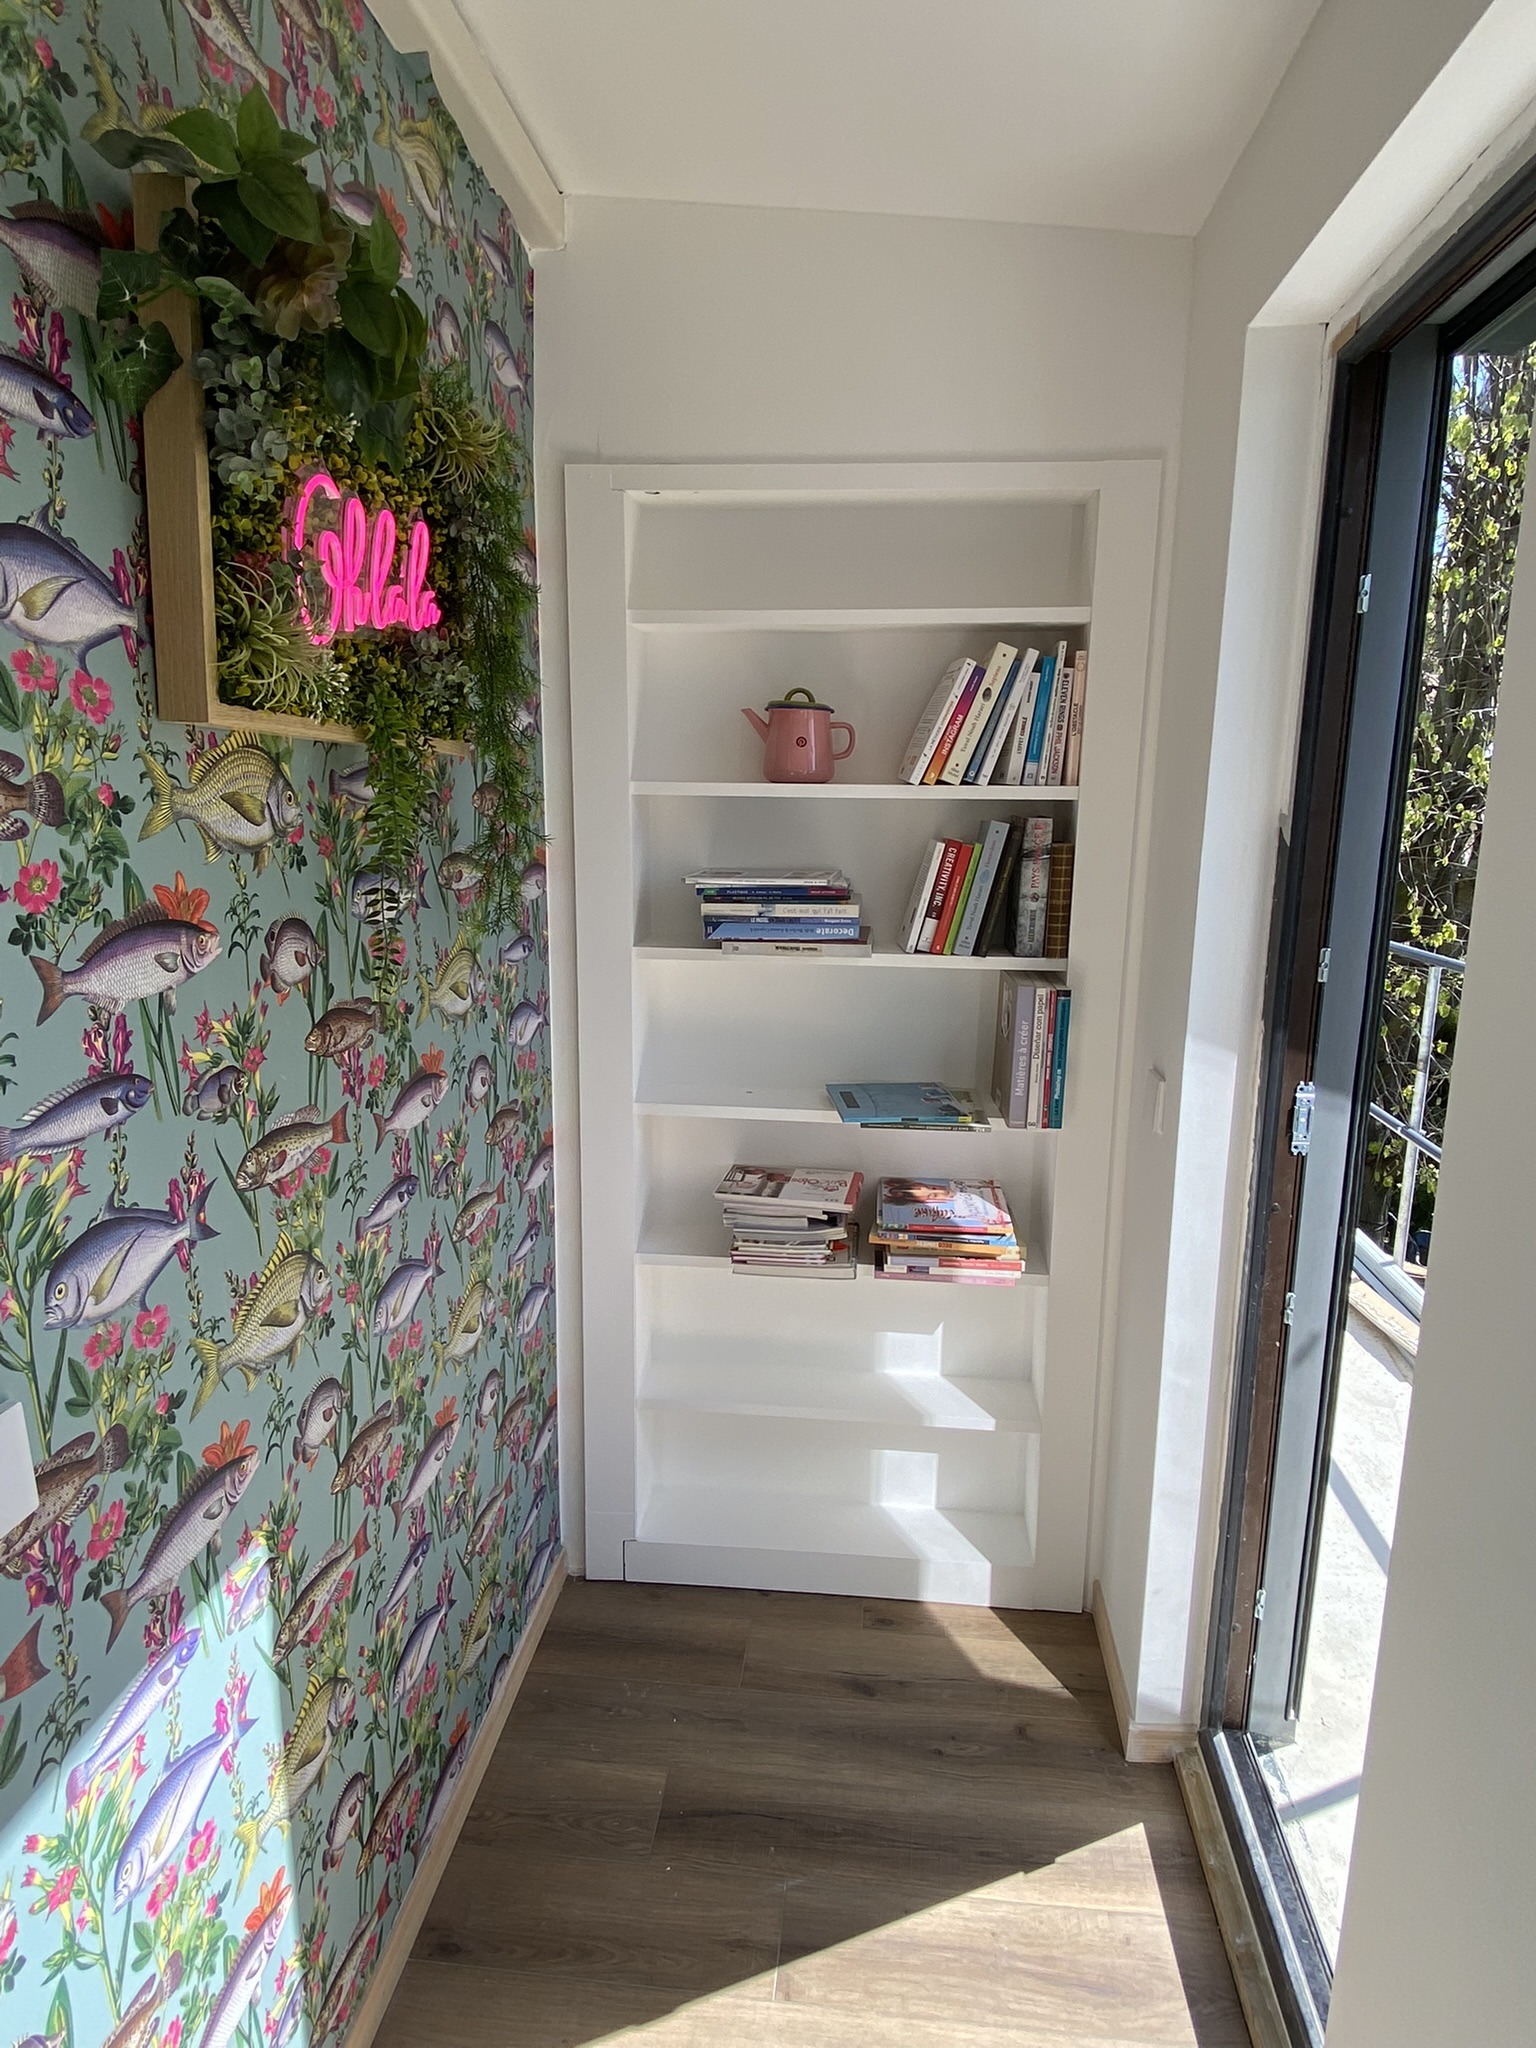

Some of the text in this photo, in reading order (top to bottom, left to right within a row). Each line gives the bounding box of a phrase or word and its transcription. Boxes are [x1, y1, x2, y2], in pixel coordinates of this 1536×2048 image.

[1058, 679, 1069, 724] ELEVEN RINGS
[941, 713, 964, 756] INSTAGRAM
[1054, 731, 1062, 746] PHIL
[1050, 745, 1061, 774] JACKSON
[937, 847, 958, 894] CREATIVITY,
[1030, 868, 1040, 889] PAYS
[932, 891, 945, 907] INC.
[816, 927, 854, 936] Decorate
[1019, 1020, 1029, 1045] créer
[1033, 1031, 1041, 1059] Diseñar
[1037, 993, 1045, 1014] papel
[1015, 1056, 1027, 1096] Matières
